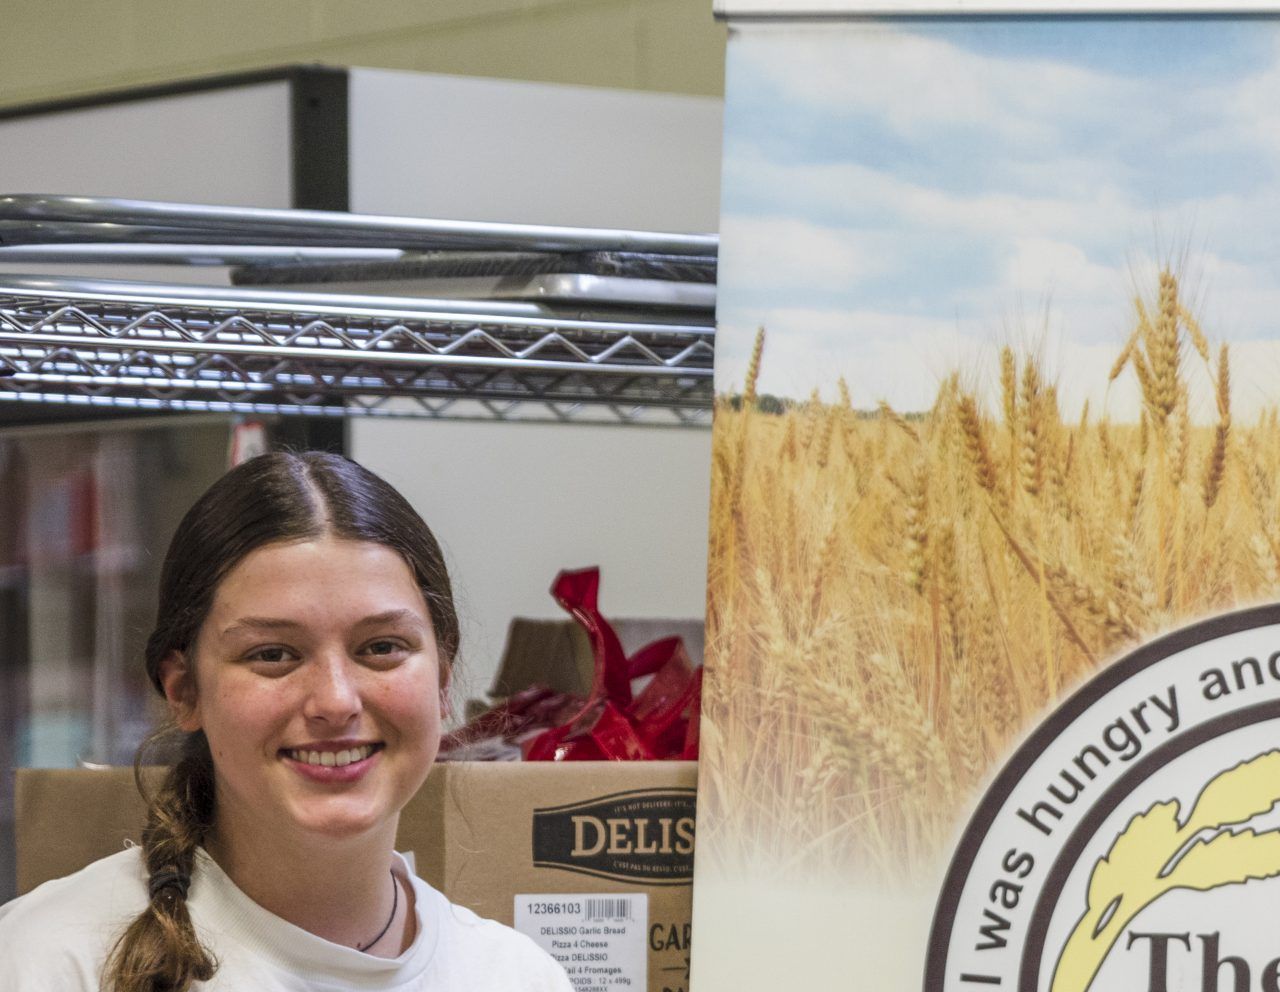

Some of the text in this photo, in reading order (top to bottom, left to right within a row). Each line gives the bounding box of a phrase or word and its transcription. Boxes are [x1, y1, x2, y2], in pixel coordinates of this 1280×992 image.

[973, 847, 1037, 953] was
[1015, 683, 1183, 835] hungry
[570, 815, 695, 857] DELIS
[528, 903, 581, 914] 12366103
[579, 926, 602, 935] Garlic
[604, 926, 626, 935] Bread
[552, 940, 571, 948] Pizza
[580, 940, 608, 948] Cheese
[584, 966, 622, 976] Fromages
